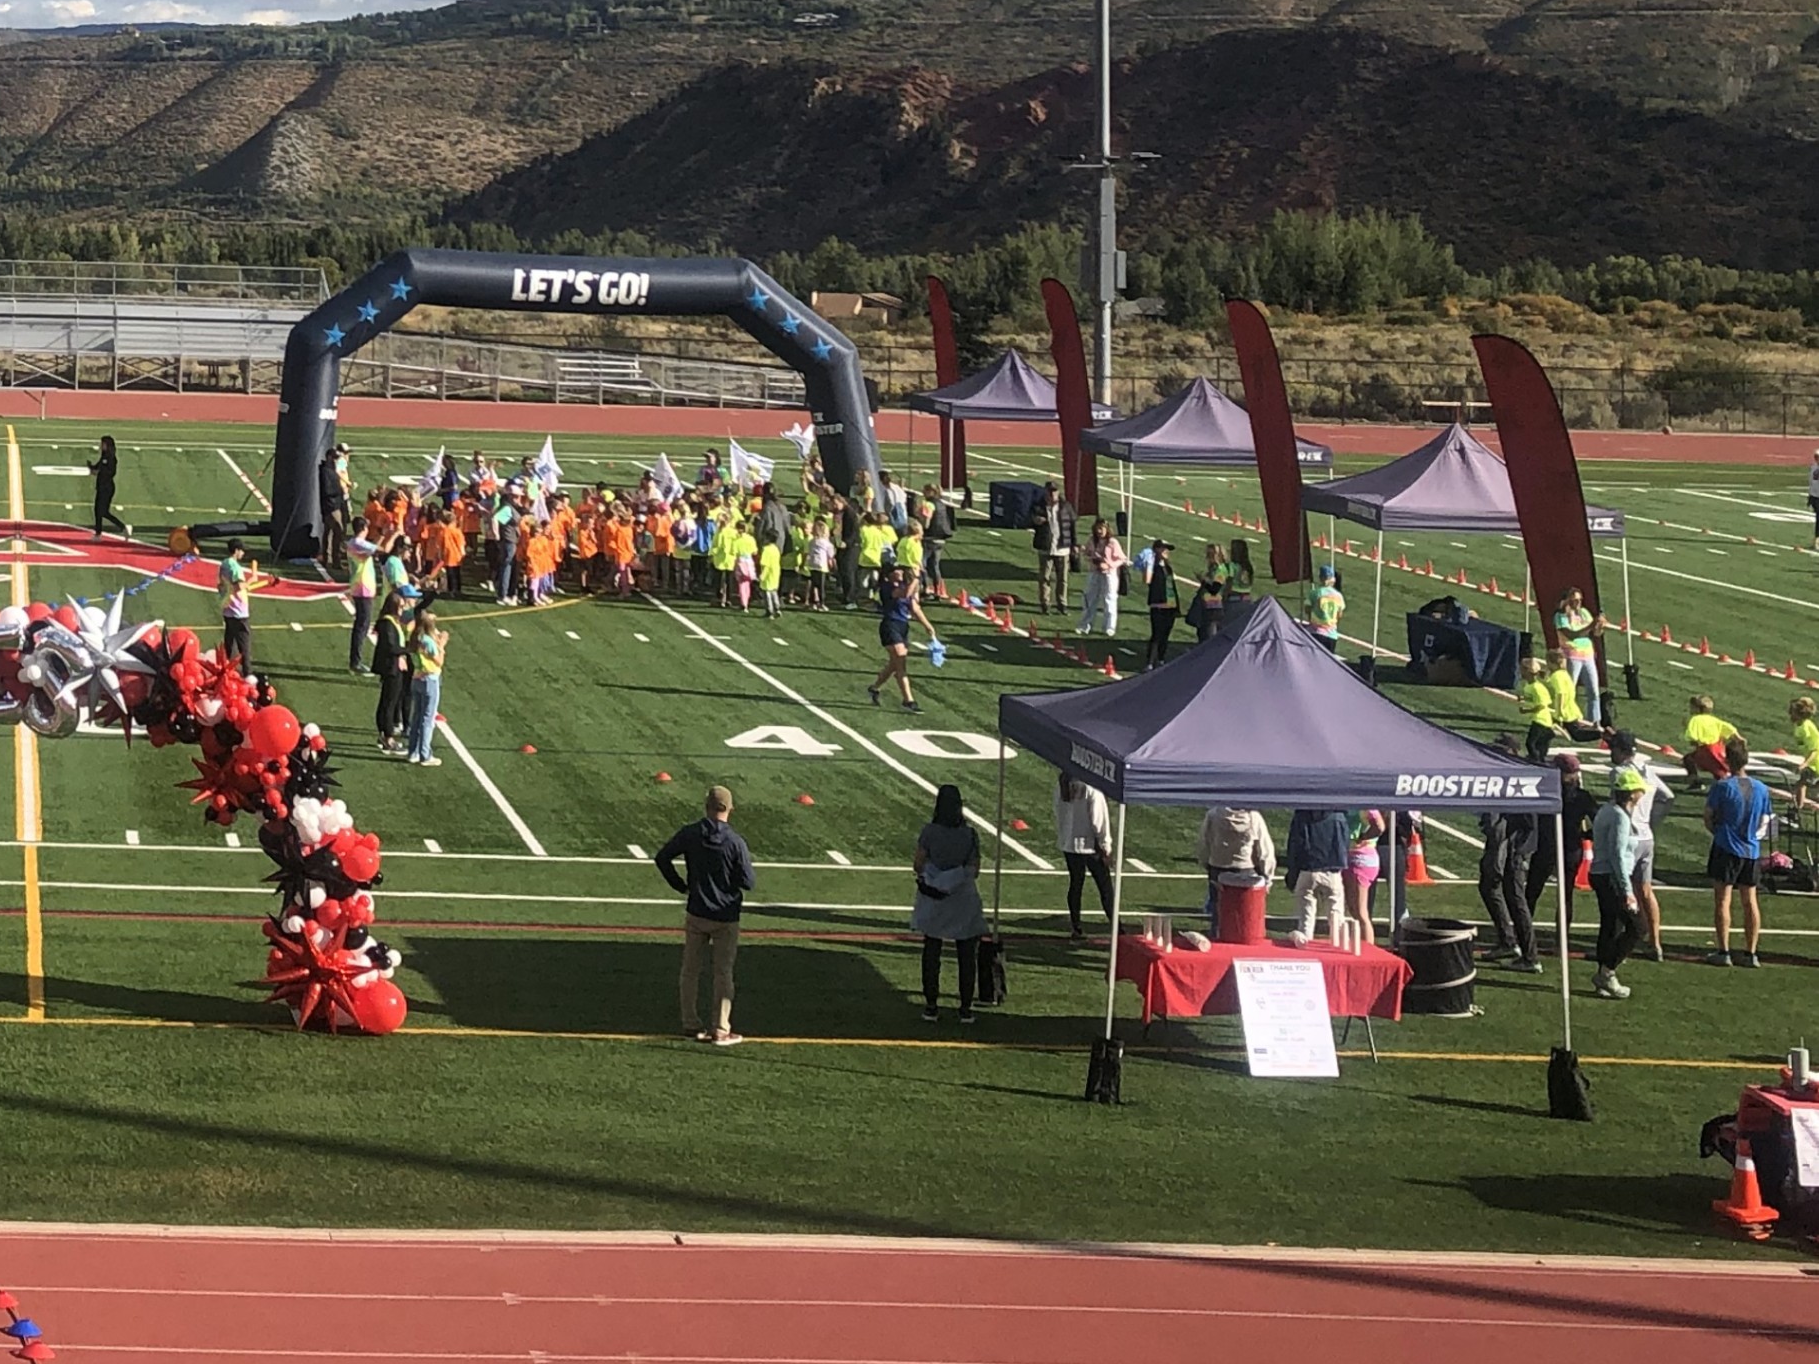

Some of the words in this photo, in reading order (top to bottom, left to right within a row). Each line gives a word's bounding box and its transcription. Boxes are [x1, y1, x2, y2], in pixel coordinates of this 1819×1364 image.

[511, 268, 593, 304] LET'S
[597, 271, 650, 306] GO!
[1395, 774, 1504, 797] BOOSTER
